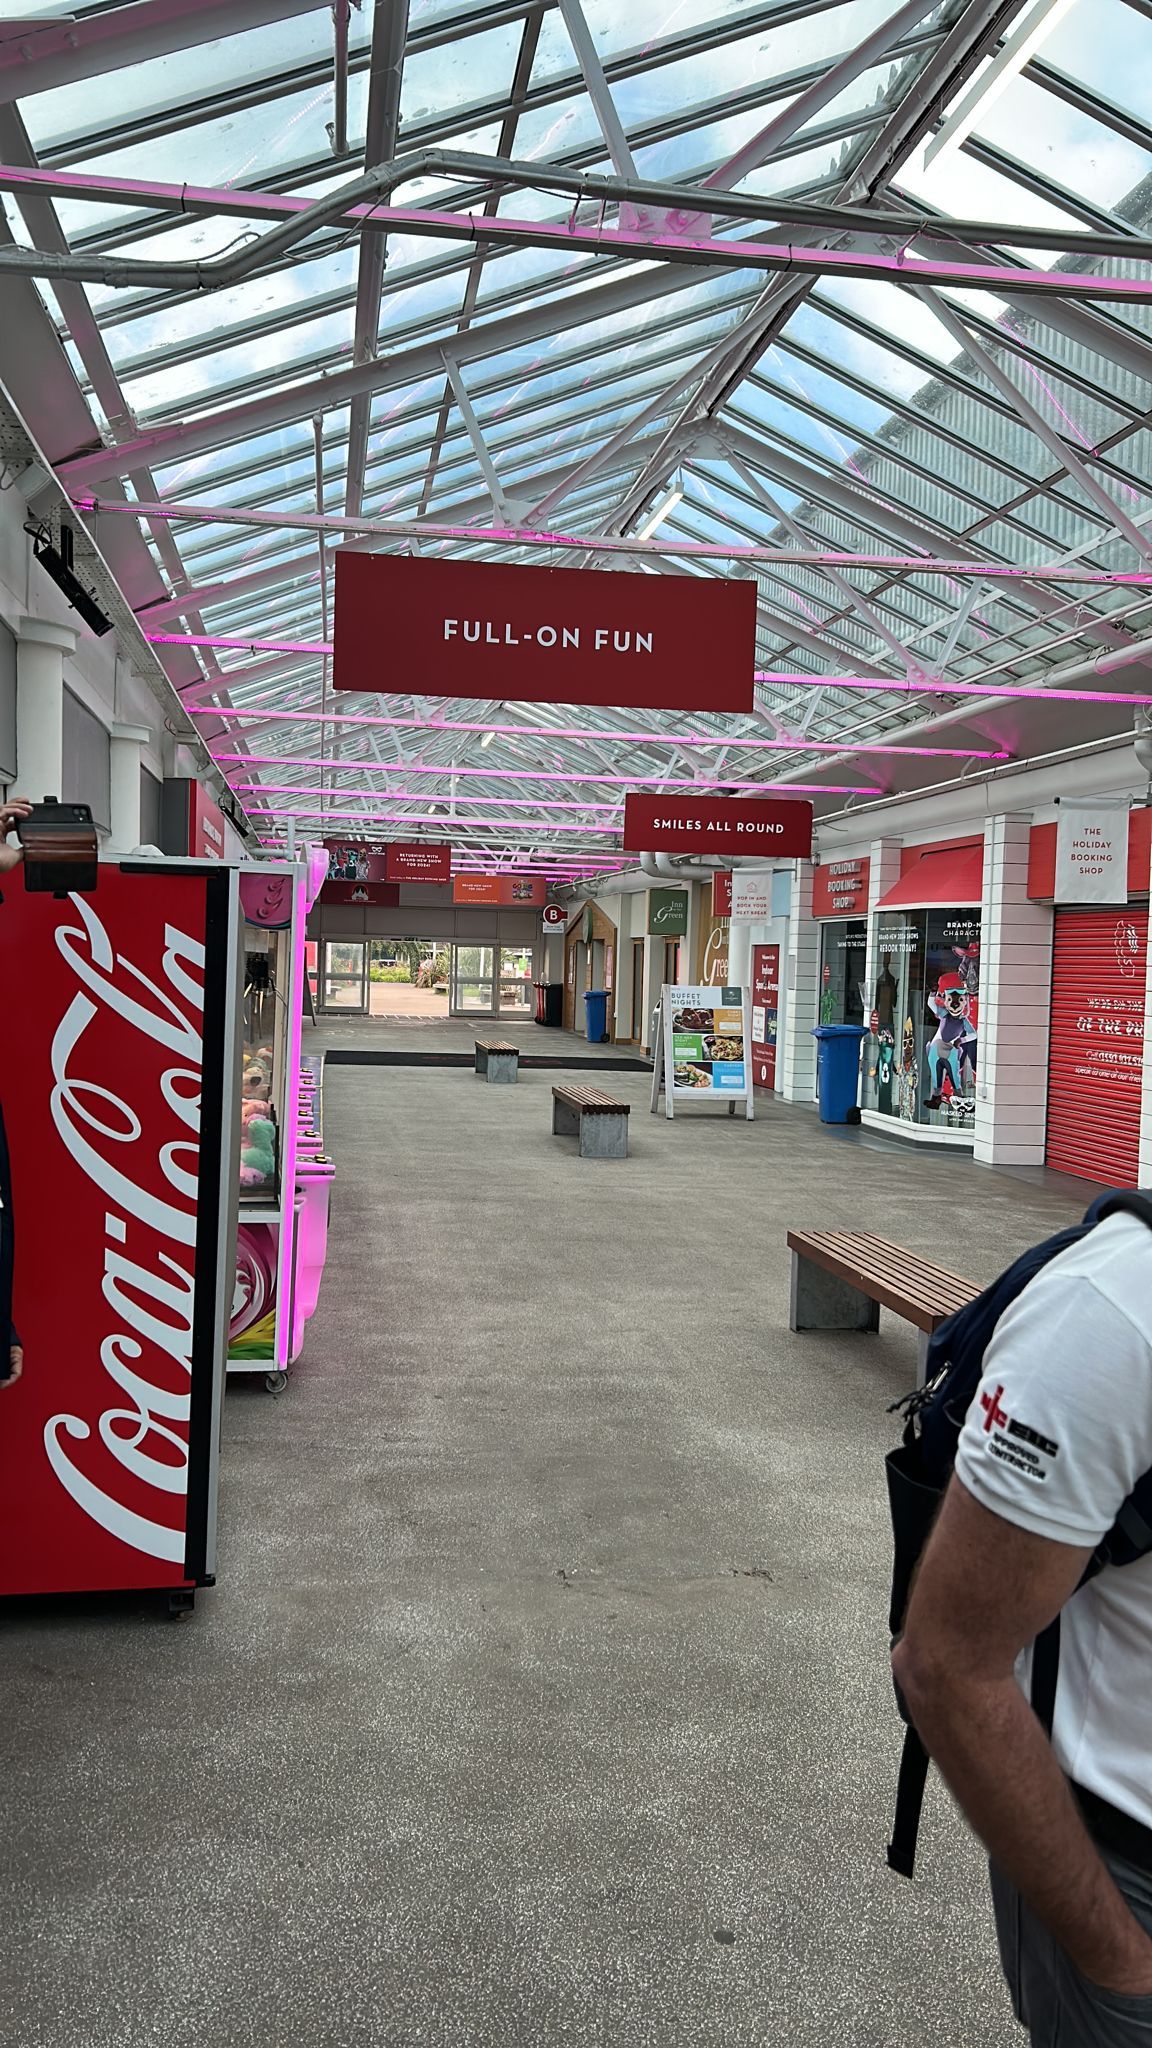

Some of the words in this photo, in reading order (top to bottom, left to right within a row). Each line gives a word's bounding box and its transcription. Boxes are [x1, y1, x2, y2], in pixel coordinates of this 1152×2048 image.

[443, 619, 580, 649] FULL-ON
[594, 629, 653, 654] FUN
[652, 818, 702, 832] SMILES
[706, 820, 733, 833] ALL
[736, 821, 785, 835] ROUND
[1084, 828, 1101, 836] THE
[1072, 840, 1112, 849] HOLIDAY
[1070, 853, 1113, 862] BOOKING
[829, 861, 859, 876] HOLIDAY
[1079, 867, 1103, 875] SHOP
[827, 878, 858, 893] BOOKING
[832, 896, 851, 909] SHOP
[549, 909, 558, 920] B
[653, 906, 683, 923] Green
[700, 927, 729, 987] Gree
